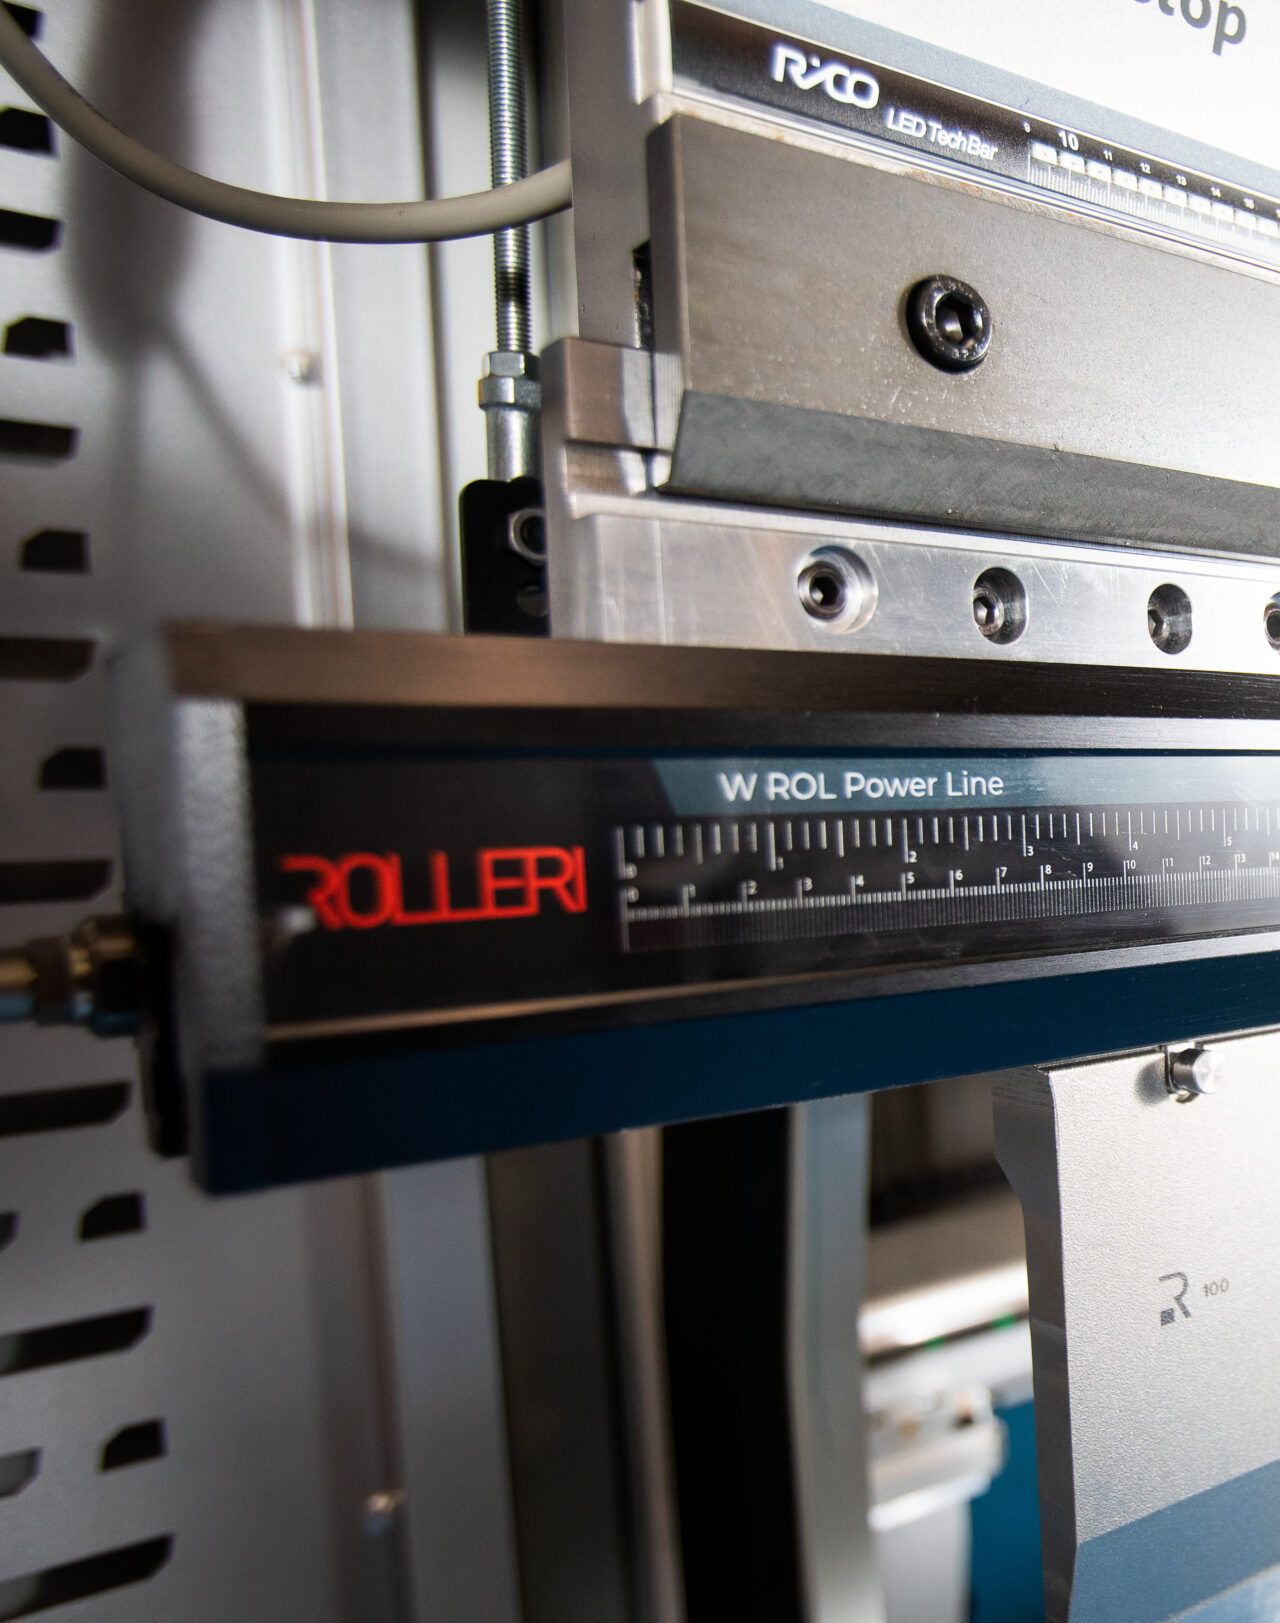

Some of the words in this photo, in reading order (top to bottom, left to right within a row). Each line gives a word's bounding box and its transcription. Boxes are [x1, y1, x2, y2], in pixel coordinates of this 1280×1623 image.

[885, 107, 927, 139] LED
[1058, 130, 1079, 150] 10
[1103, 149, 1113, 161] 11
[1140, 162, 1151, 174] 12
[719, 772, 758, 801] W
[767, 772, 837, 801] ROL
[845, 771, 938, 799] Power
[946, 770, 1004, 797] Line
[909, 851, 918, 864] 2
[1026, 845, 1034, 857] 3
[1132, 840, 1139, 851] 4
[1227, 836, 1233, 847] 5
[803, 877, 813, 891] 3
[855, 874, 864, 887] 4
[906, 872, 915, 885] 5
[955, 869, 963, 881] 6
[1000, 867, 1008, 878] 7
[1045, 864, 1052, 875] 8
[1087, 862, 1094, 872] 9
[1126, 860, 1136, 870] 10
[1165, 857, 1174, 868] 11
[1201, 855, 1211, 865] 12
[1237, 853, 1246, 863] 13
[1271, 851, 1280, 861] 14
[1203, 1278, 1229, 1297] 100
